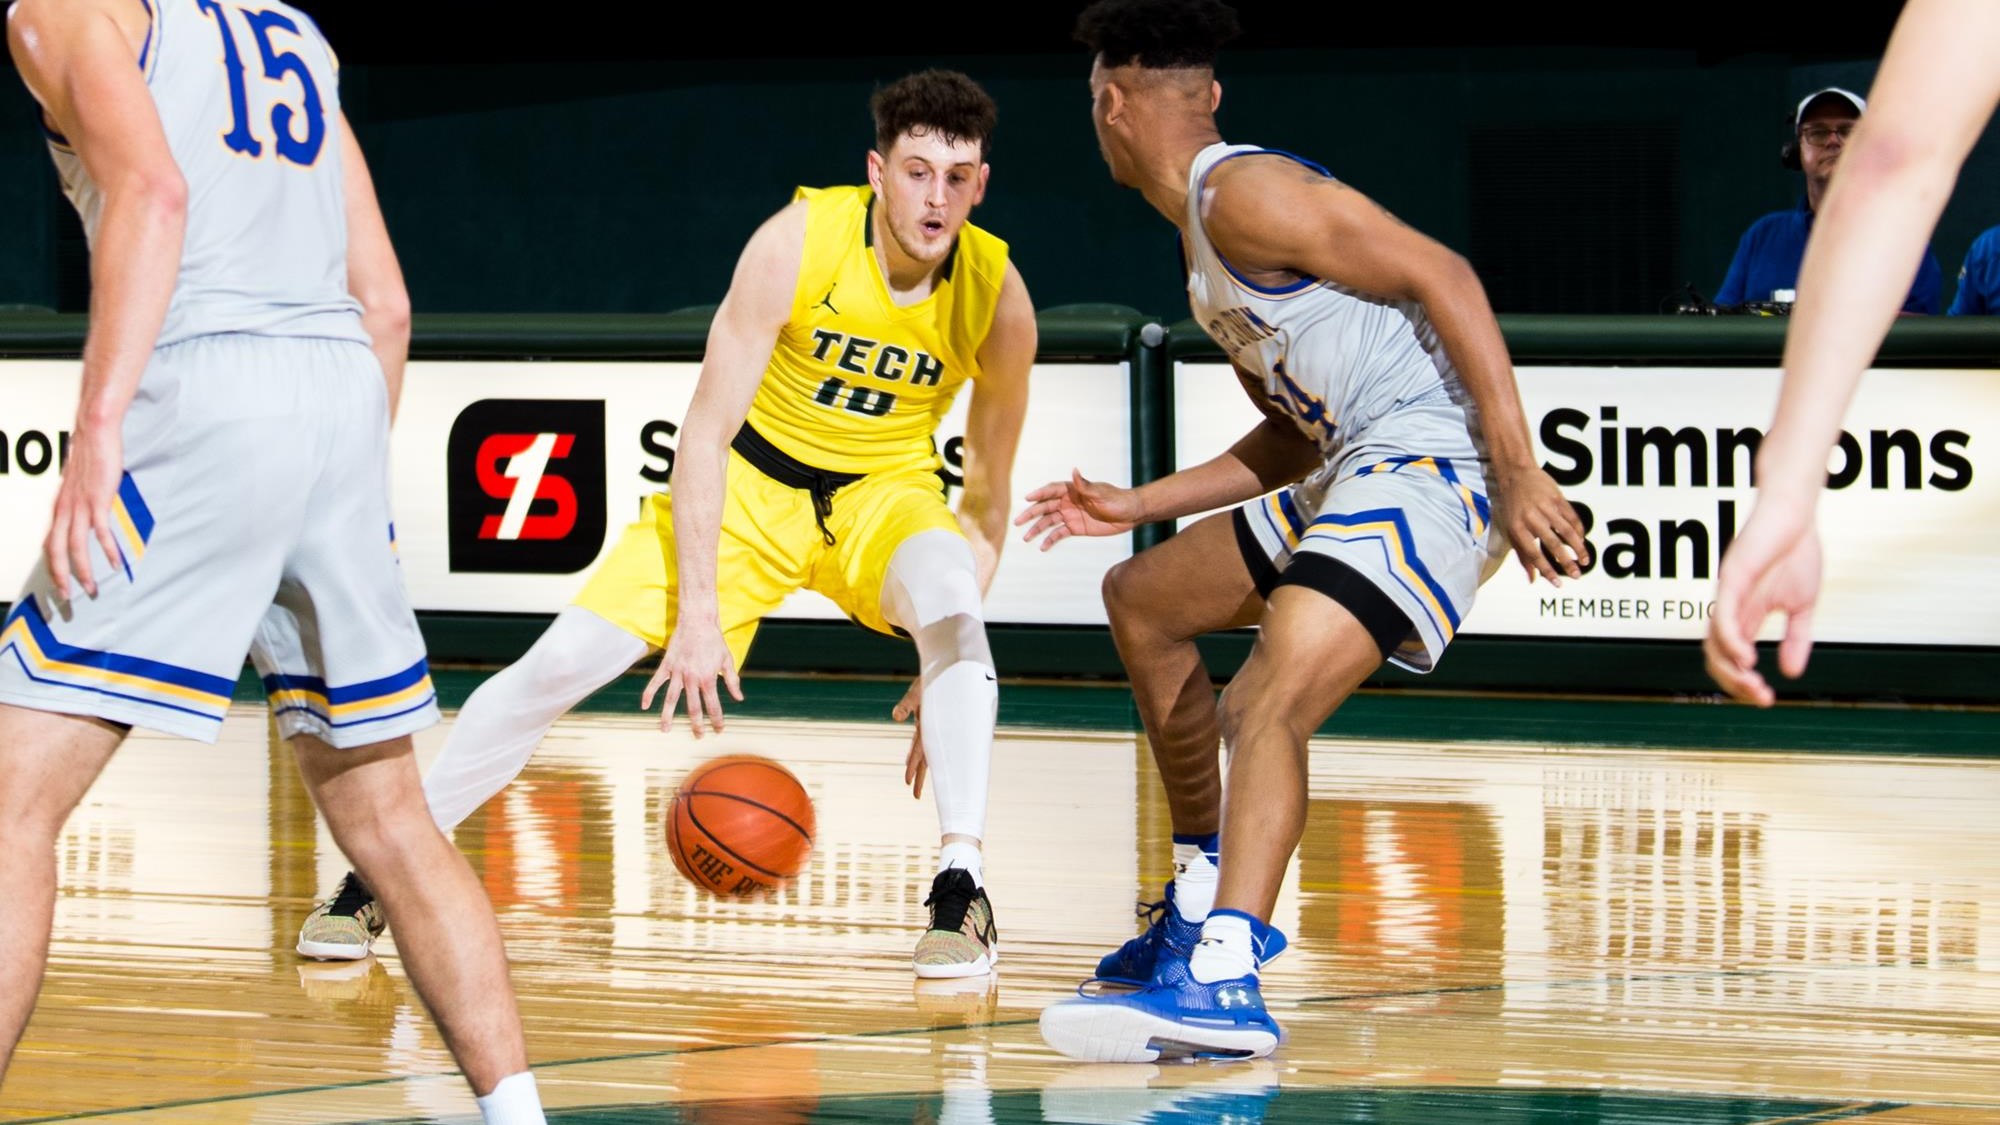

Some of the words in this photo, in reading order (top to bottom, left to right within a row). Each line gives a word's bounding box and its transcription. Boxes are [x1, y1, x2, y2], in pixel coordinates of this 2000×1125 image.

[194, 0, 326, 167] 15
[812, 328, 945, 387] TECH
[813, 376, 897, 417] 10
[1540, 499, 1735, 579] Ban
[1539, 597, 1650, 619] MEMBER
[691, 843, 734, 886] THE
